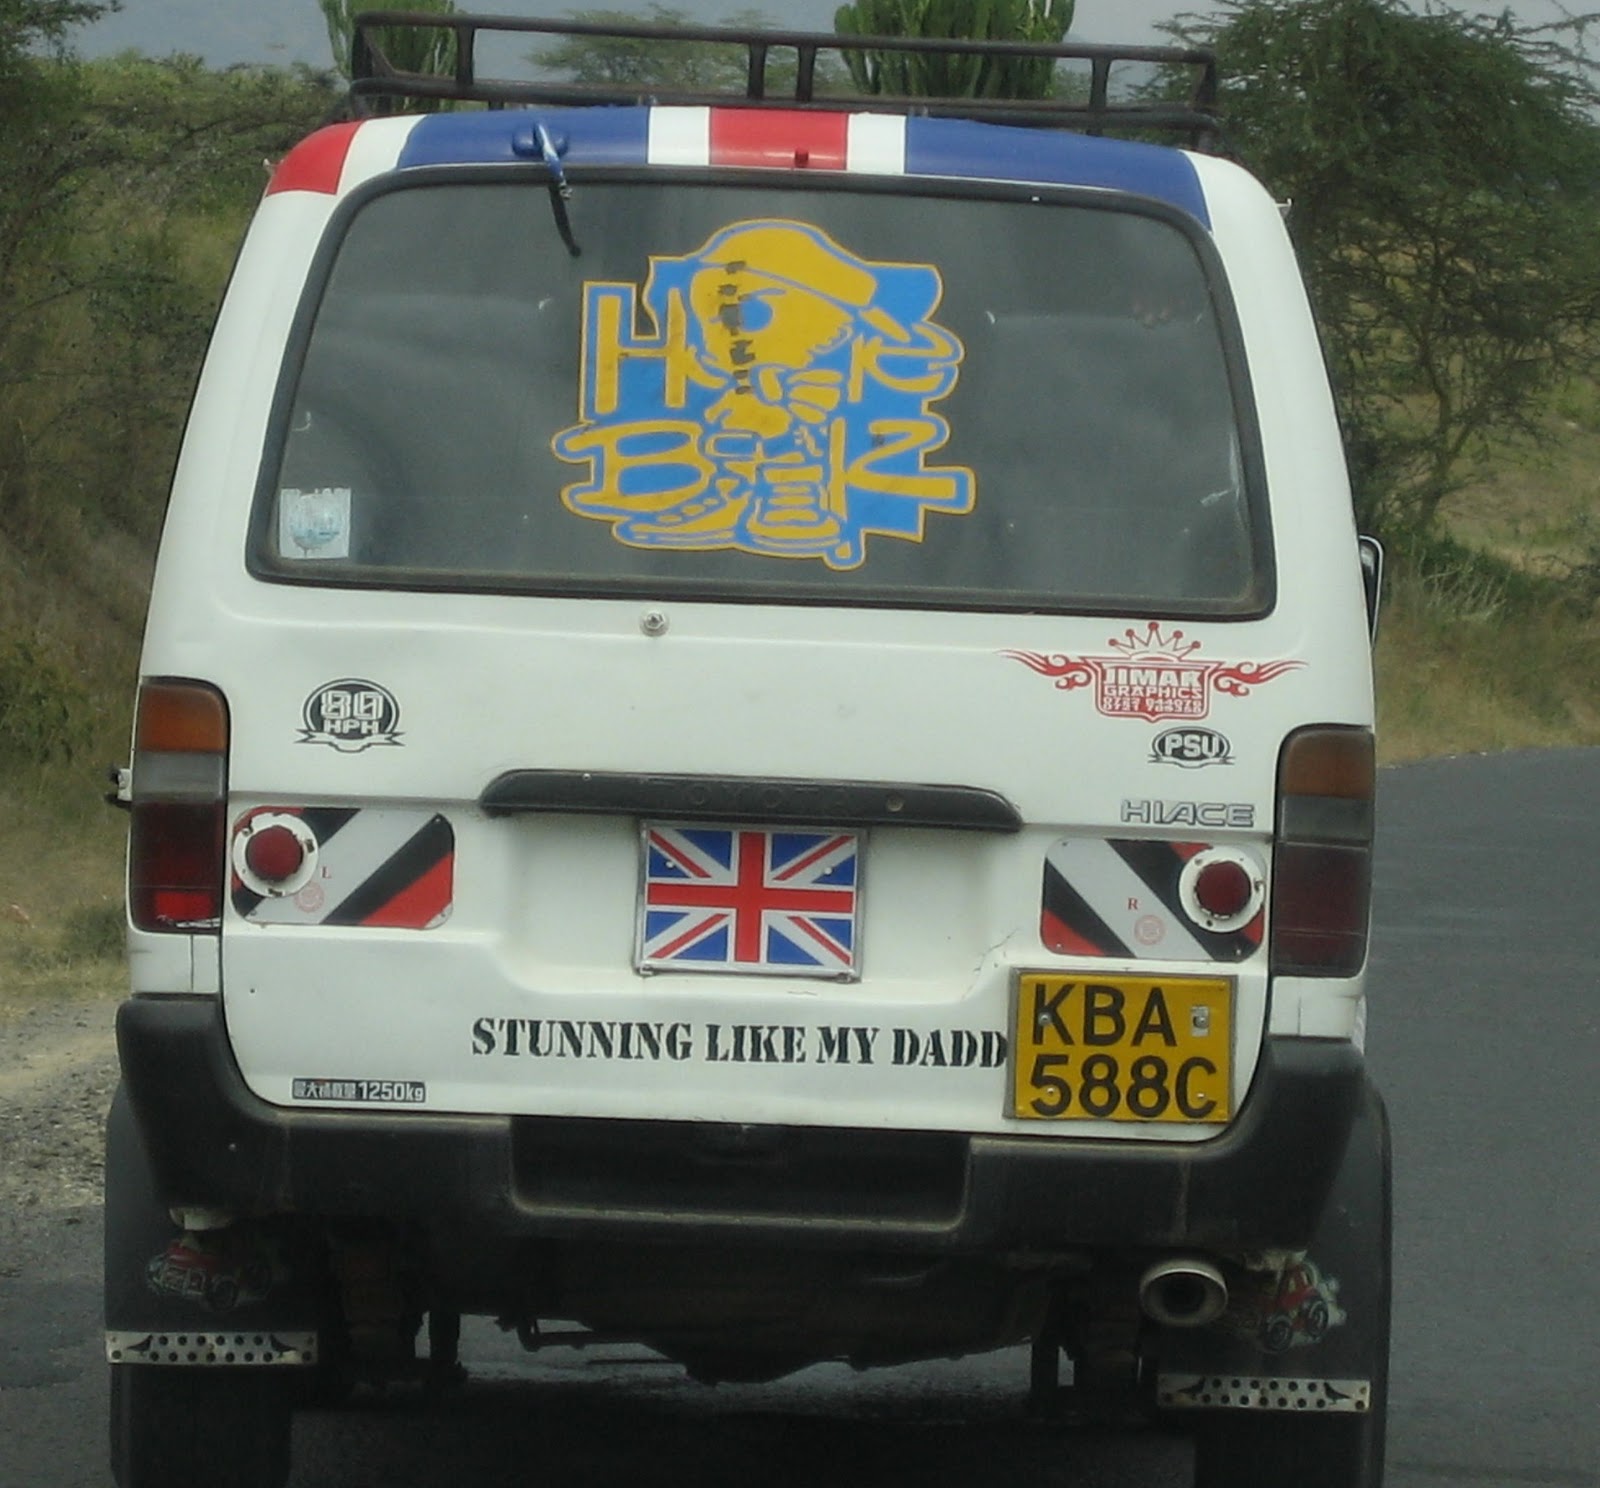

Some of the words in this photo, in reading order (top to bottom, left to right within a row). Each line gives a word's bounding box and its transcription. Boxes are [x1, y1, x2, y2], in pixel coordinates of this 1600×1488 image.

[320, 689, 384, 720] 80
[1103, 684, 1203, 700] GRAPHICS
[323, 719, 380, 734] HPH
[1164, 733, 1220, 757] PSU
[1120, 799, 1254, 828] HIACE
[322, 866, 332, 879] L
[1127, 897, 1139, 910] R
[1032, 983, 1177, 1047] KBA
[472, 1017, 692, 1061] STUNNING
[704, 1023, 807, 1063] LIKE
[815, 1026, 880, 1065] MY
[1030, 1053, 1218, 1119] 588C
